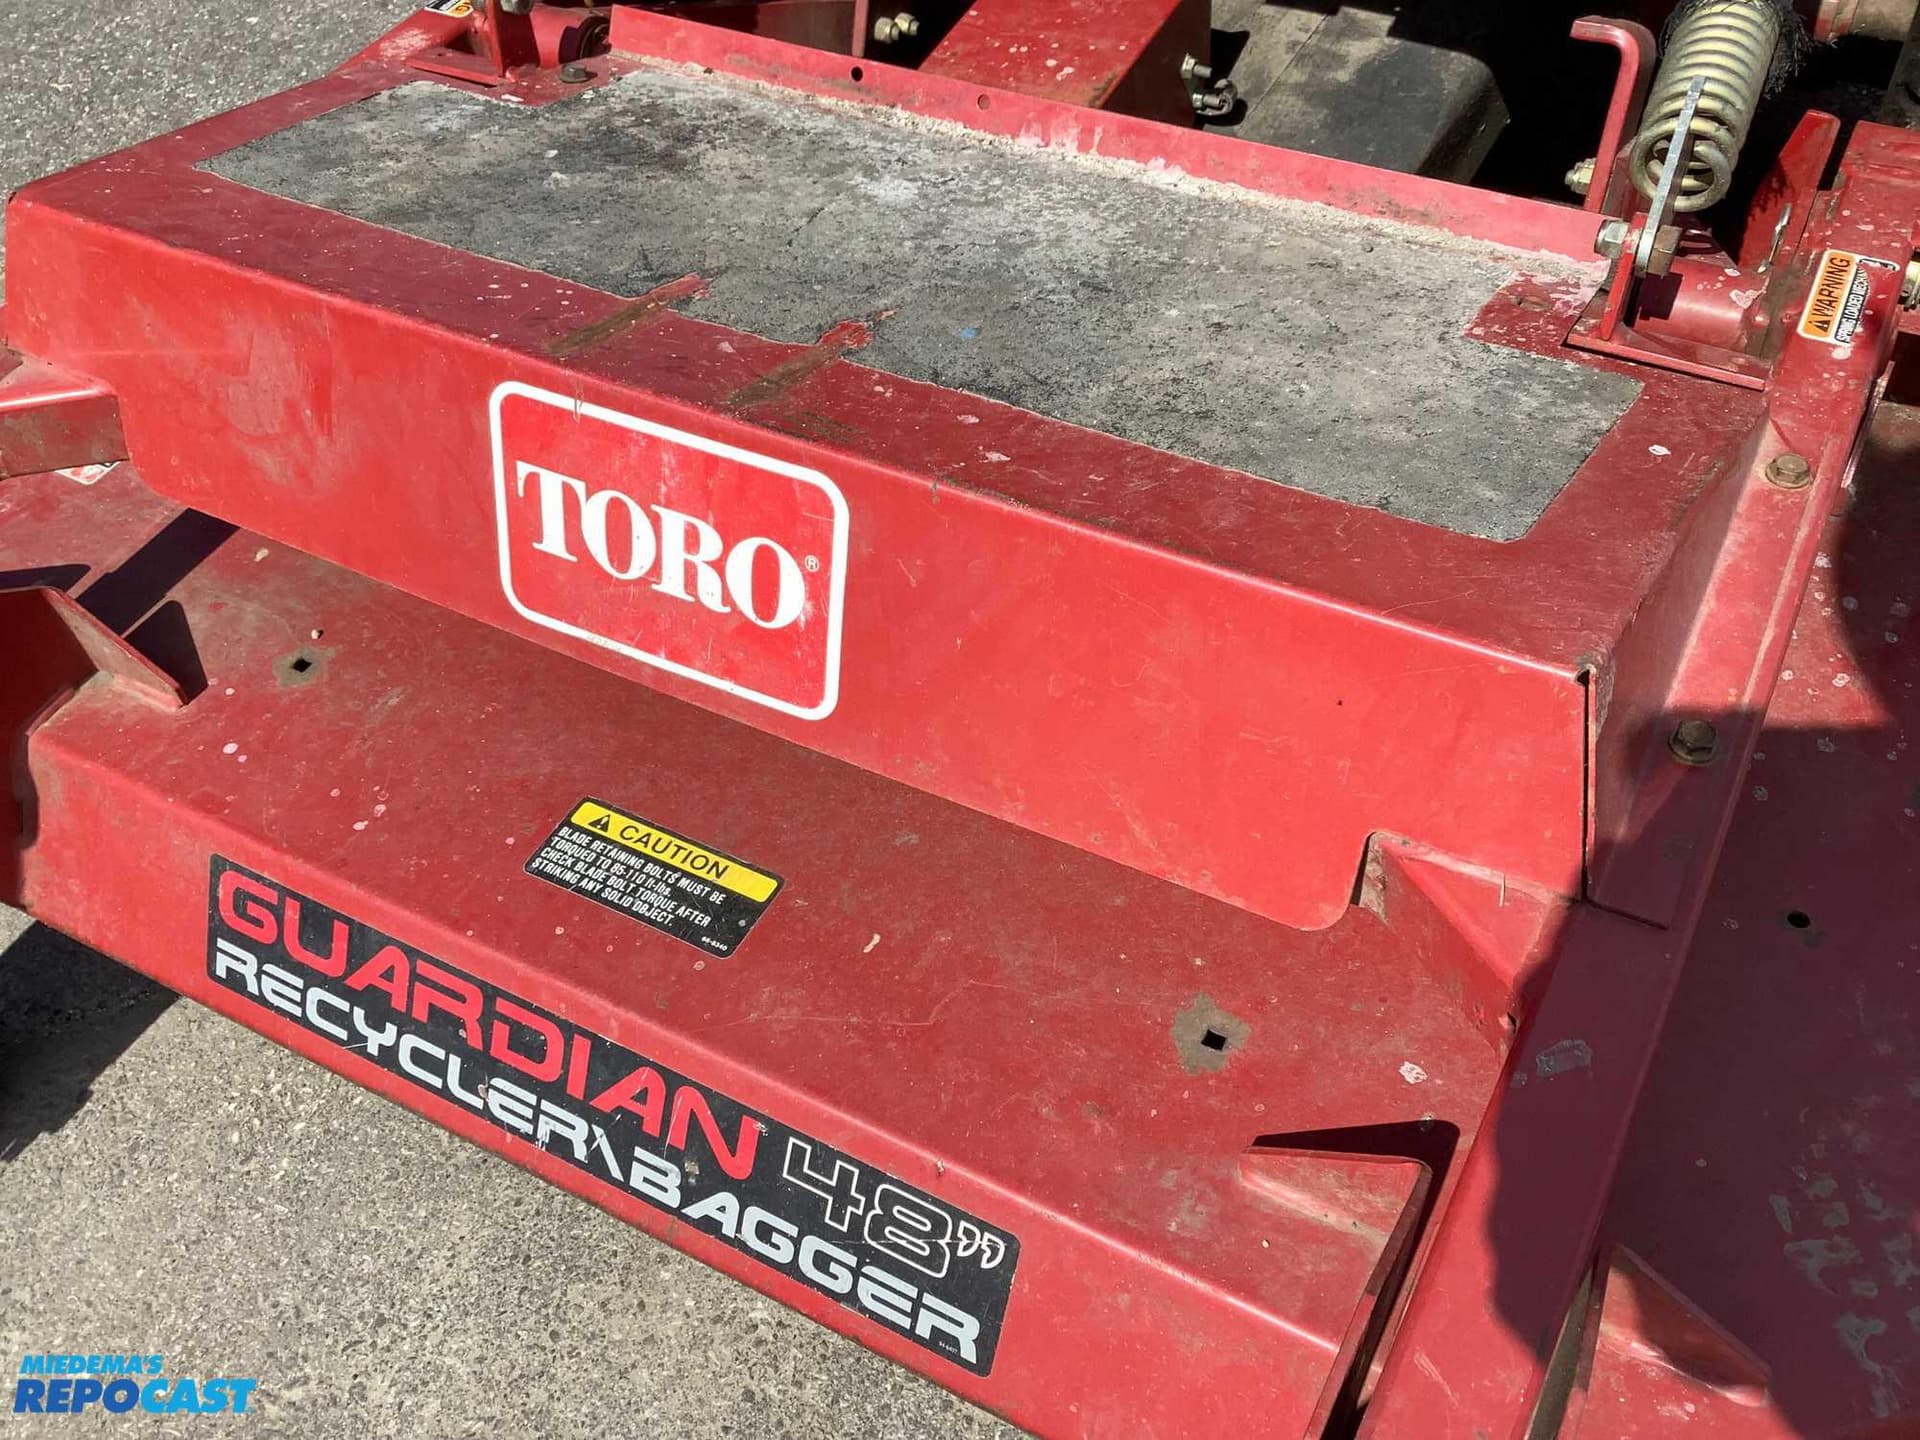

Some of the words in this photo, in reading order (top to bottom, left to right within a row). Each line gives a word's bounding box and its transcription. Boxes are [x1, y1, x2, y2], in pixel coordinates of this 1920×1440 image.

[1812, 257, 1850, 318] WARNING
[1844, 294, 1864, 319] LOADED
[550, 836, 597, 863] TORQUED
[596, 855, 612, 869] TO
[610, 862, 646, 884] 85-110
[558, 826, 592, 847] BLADE
[590, 840, 645, 869] RETAINING
[643, 862, 679, 884] BOLTS
[677, 877, 711, 897] MUST
[709, 891, 727, 905] BE
[619, 825, 730, 879] CAUTION
[532, 857, 580, 884] STRIKING
[578, 880, 603, 894] ANY
[601, 887, 634, 907] SOLID
[632, 900, 675, 927] OBJECT.
[540, 847, 576, 868] CHECK
[574, 859, 609, 882] BLADE
[607, 875, 637, 893] BOLT
[635, 887, 677, 912] TORQUE
[675, 905, 711, 928] AFTER
[218, 870, 760, 1180] GUARDIAN
